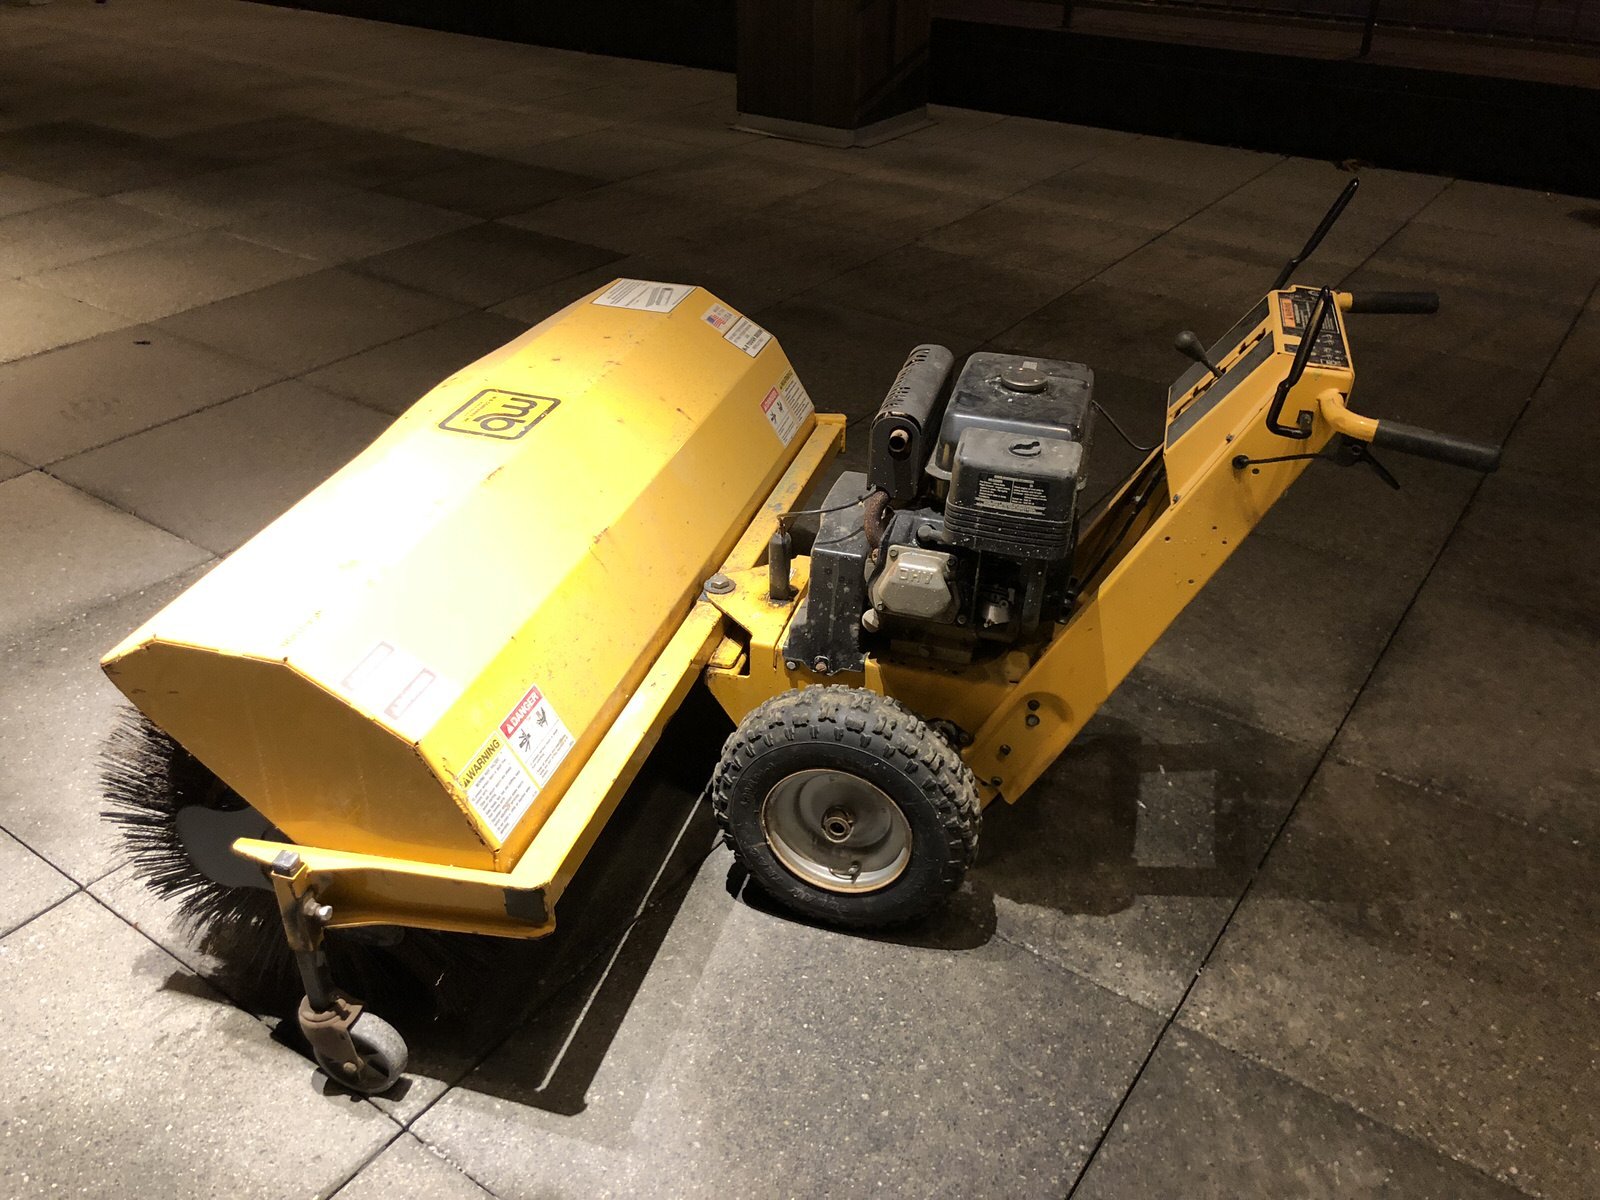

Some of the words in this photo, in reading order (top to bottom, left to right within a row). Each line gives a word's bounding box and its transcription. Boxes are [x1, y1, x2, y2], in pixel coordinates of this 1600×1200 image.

[899, 567, 934, 585] OHV
[508, 691, 540, 726] DANGER
[466, 739, 501, 780] WARNING
